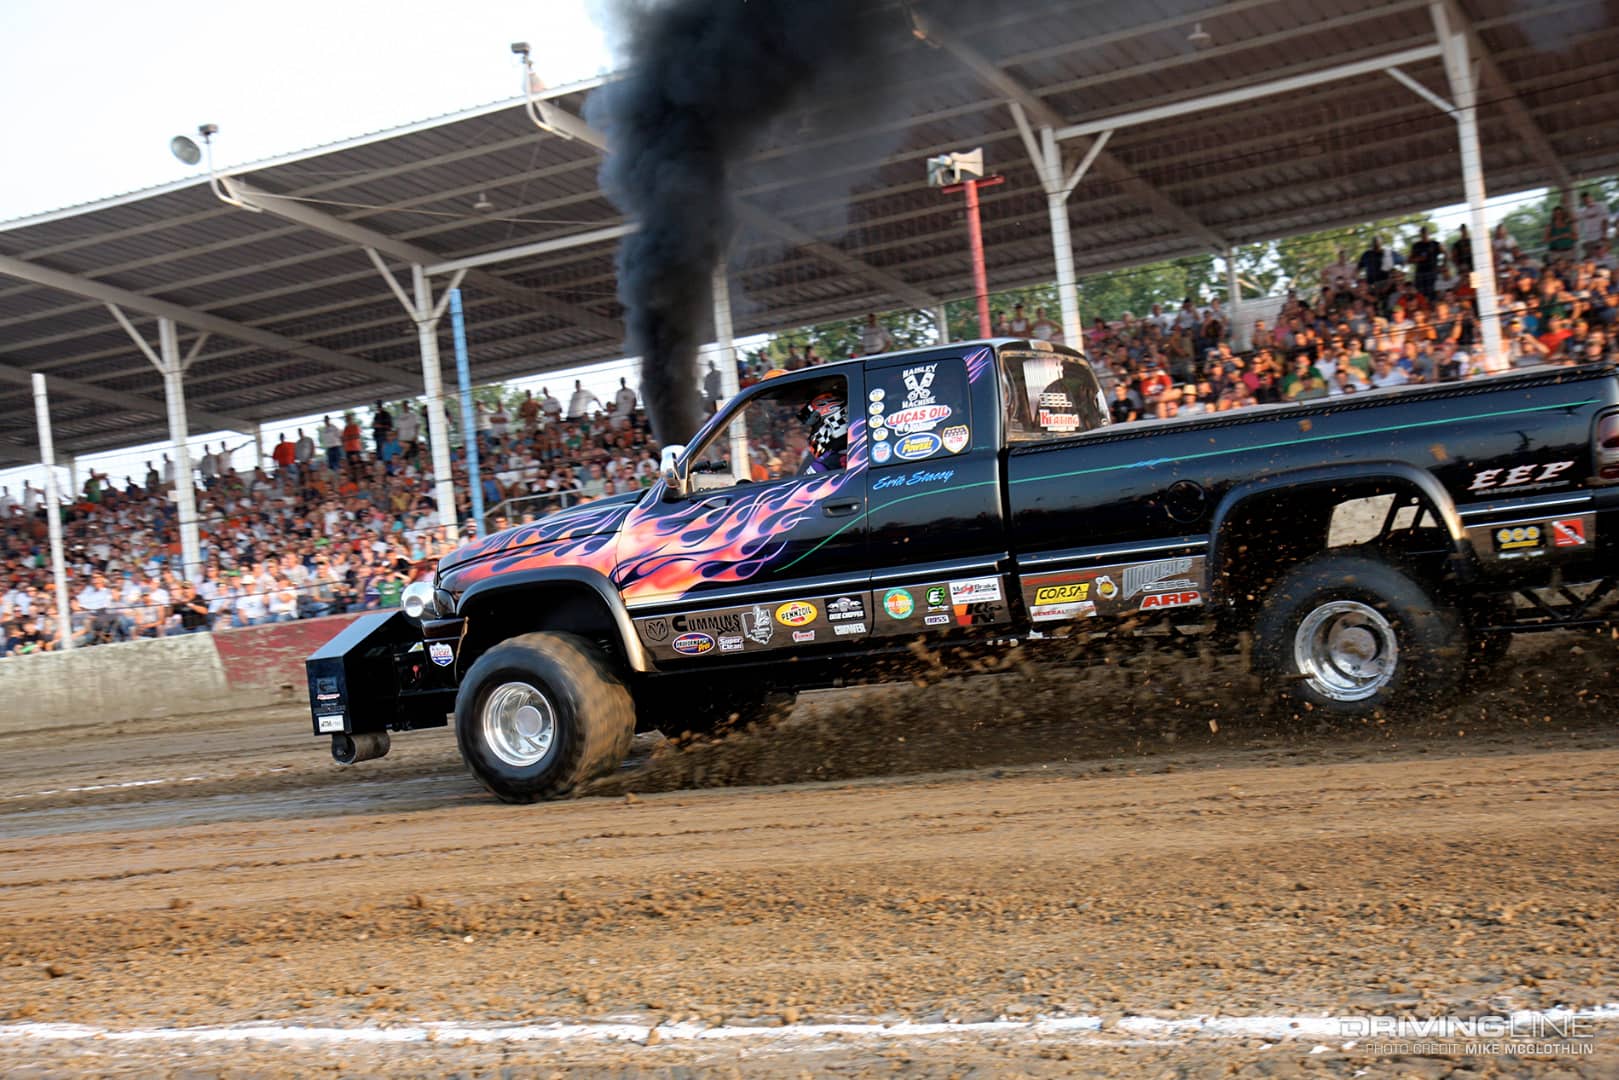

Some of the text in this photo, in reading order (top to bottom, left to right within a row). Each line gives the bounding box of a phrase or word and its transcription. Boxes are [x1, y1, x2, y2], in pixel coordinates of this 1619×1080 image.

[888, 406, 948, 426] LUCAS OIL
[1142, 592, 1200, 608] ARP
[672, 613, 741, 634] CUMMINS
[781, 608, 812, 621] PENNZOIL
